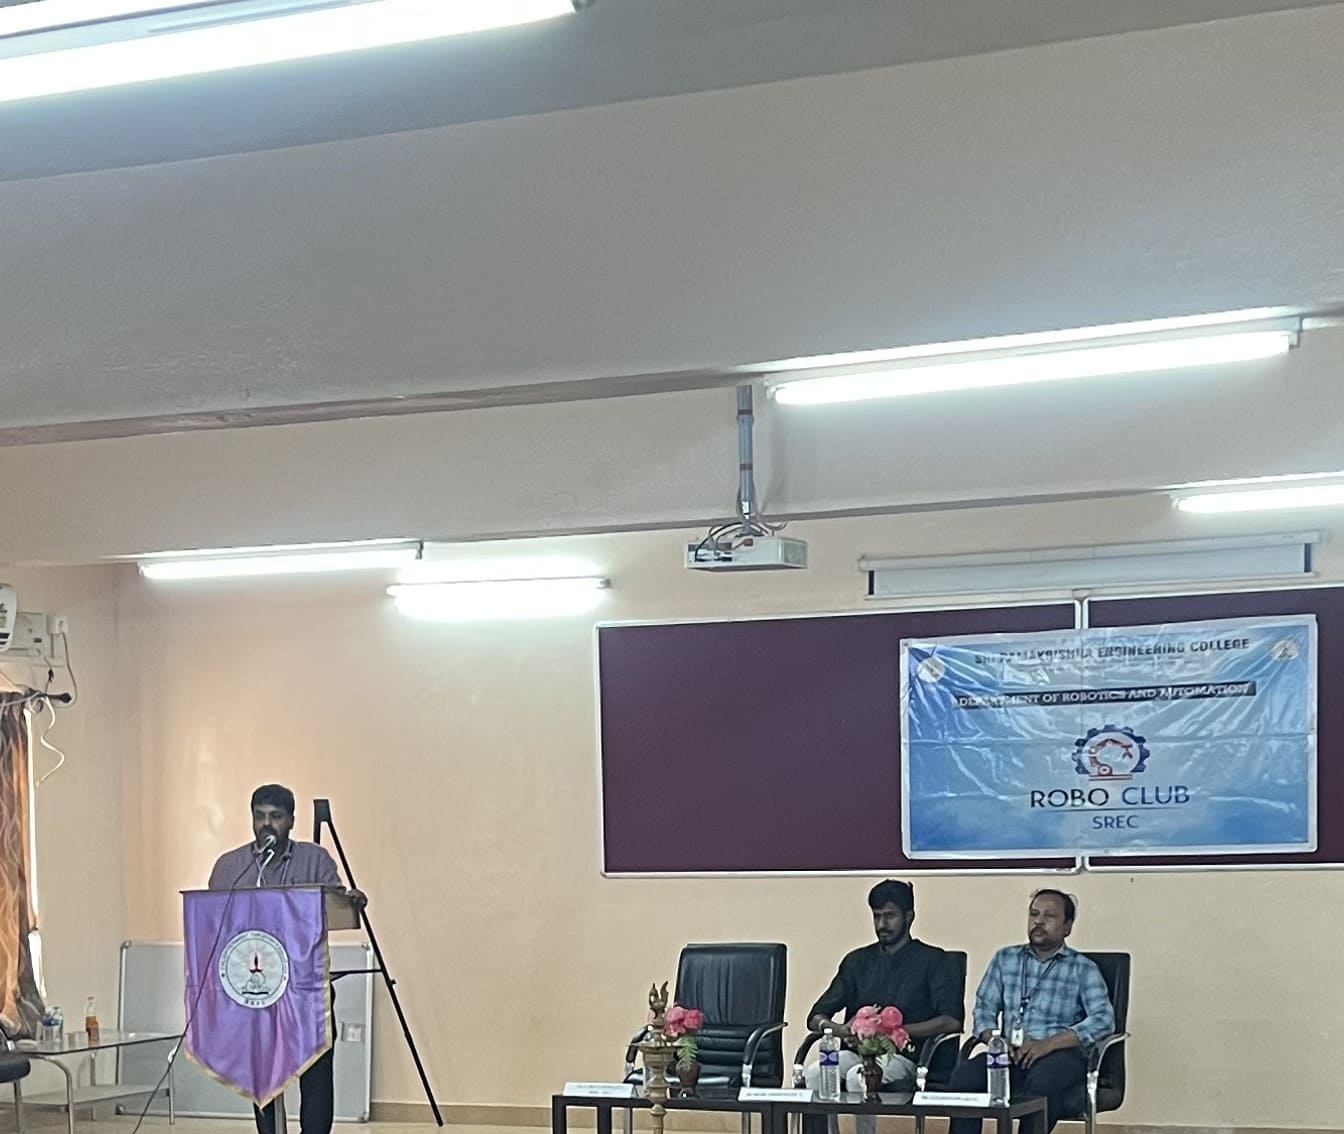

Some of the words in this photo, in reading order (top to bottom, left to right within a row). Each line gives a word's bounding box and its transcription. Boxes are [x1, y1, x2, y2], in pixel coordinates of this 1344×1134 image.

[999, 646, 1093, 664] RAKRISHNA
[1097, 642, 1185, 658] ENGINEERING
[1190, 638, 1250, 653] COLLEGE
[959, 691, 1040, 708] DETMENT
[1042, 692, 1060, 704] OF
[1062, 689, 1127, 703] ROBOTICS
[1128, 687, 1157, 700] AND
[1159, 683, 1250, 699] AUTOMATION
[1030, 787, 1109, 808] ROBO
[1121, 784, 1191, 806] CLUB
[1092, 814, 1139, 830] SREC
